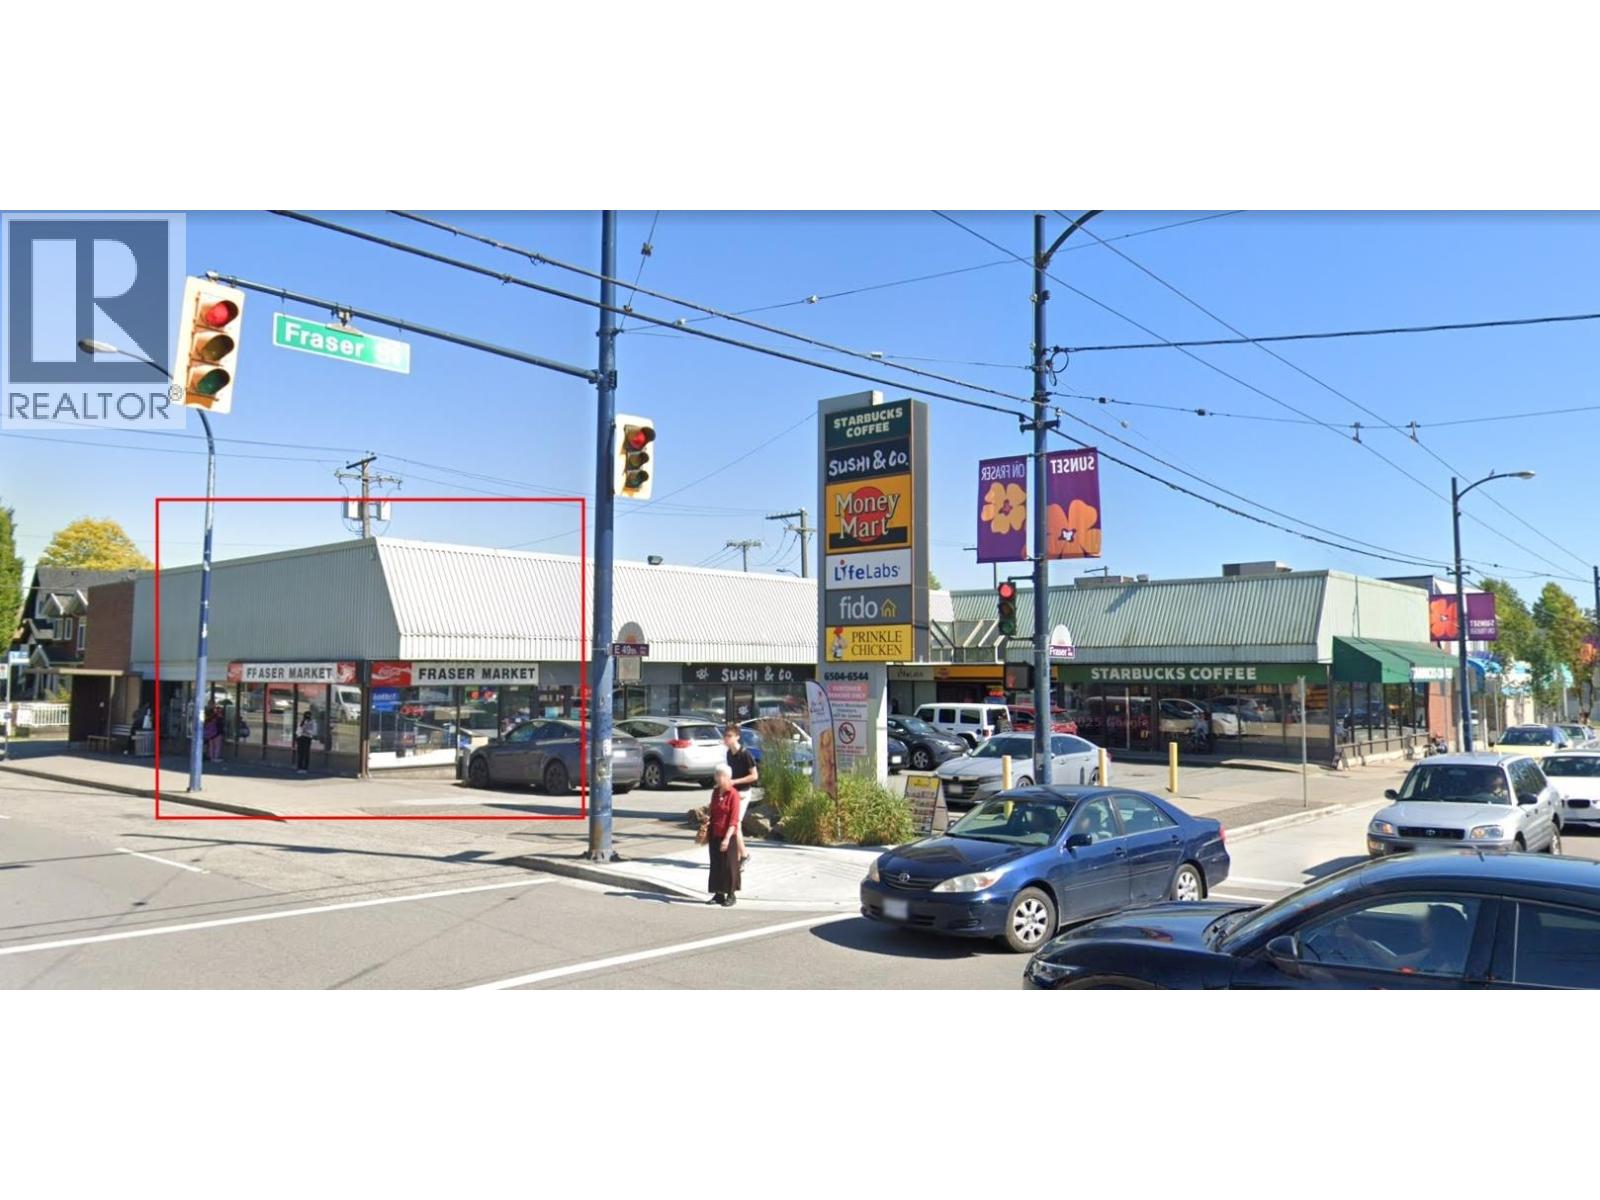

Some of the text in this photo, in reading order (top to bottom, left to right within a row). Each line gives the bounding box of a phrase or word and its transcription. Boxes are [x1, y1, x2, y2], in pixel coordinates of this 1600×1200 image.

[285, 321, 365, 357] Fraser
[834, 407, 903, 429] STARBUCKS
[846, 421, 890, 438] COFFEE
[828, 455, 870, 477] SUSHI
[873, 449, 887, 470] &
[834, 492, 901, 520] Money
[839, 516, 889, 539] Mart
[834, 560, 899, 581] LifeLabs
[840, 595, 878, 619] fido
[851, 631, 902, 643] PRINKLE
[851, 644, 902, 656] CHICKEN
[288, 667, 333, 679] MARKET
[418, 668, 535, 680] FRASER MARKET
[721, 668, 758, 682] SUSHI
[764, 666, 775, 681] &
[824, 672, 869, 681] 6504-6544
[1091, 667, 1257, 680] STARBUCKS COFFEE
